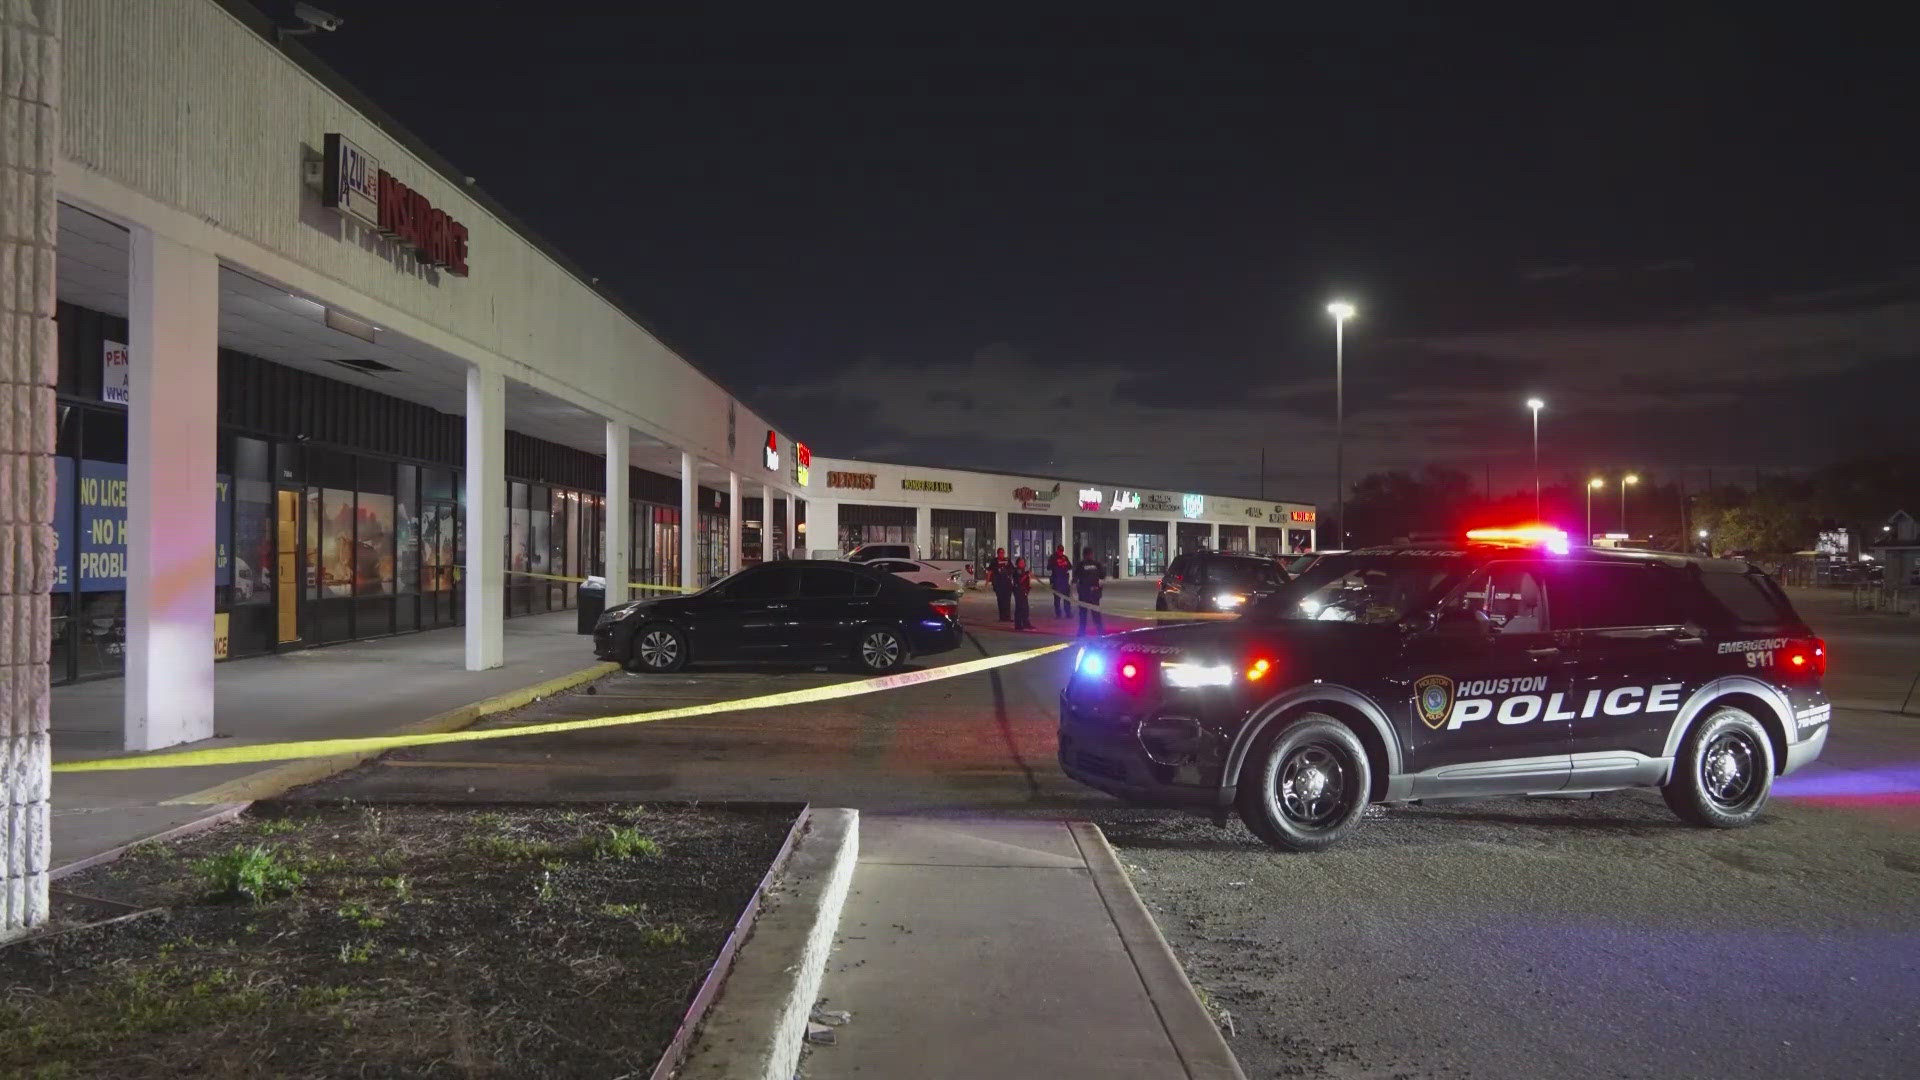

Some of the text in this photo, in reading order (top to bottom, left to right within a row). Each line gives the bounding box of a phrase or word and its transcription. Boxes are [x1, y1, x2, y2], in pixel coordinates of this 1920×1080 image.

[827, 472, 877, 489] DENTIST
[81, 477, 98, 506] NO
[92, 519, 114, 545] NO
[1398, 549, 1469, 557] POLICE
[1717, 638, 1789, 655] EMERGENCY
[1746, 651, 1774, 668] 911
[1418, 678, 1449, 689] HOUSTON
[1456, 676, 1547, 698] HOUSTON
[1446, 683, 1682, 731] POLICE
